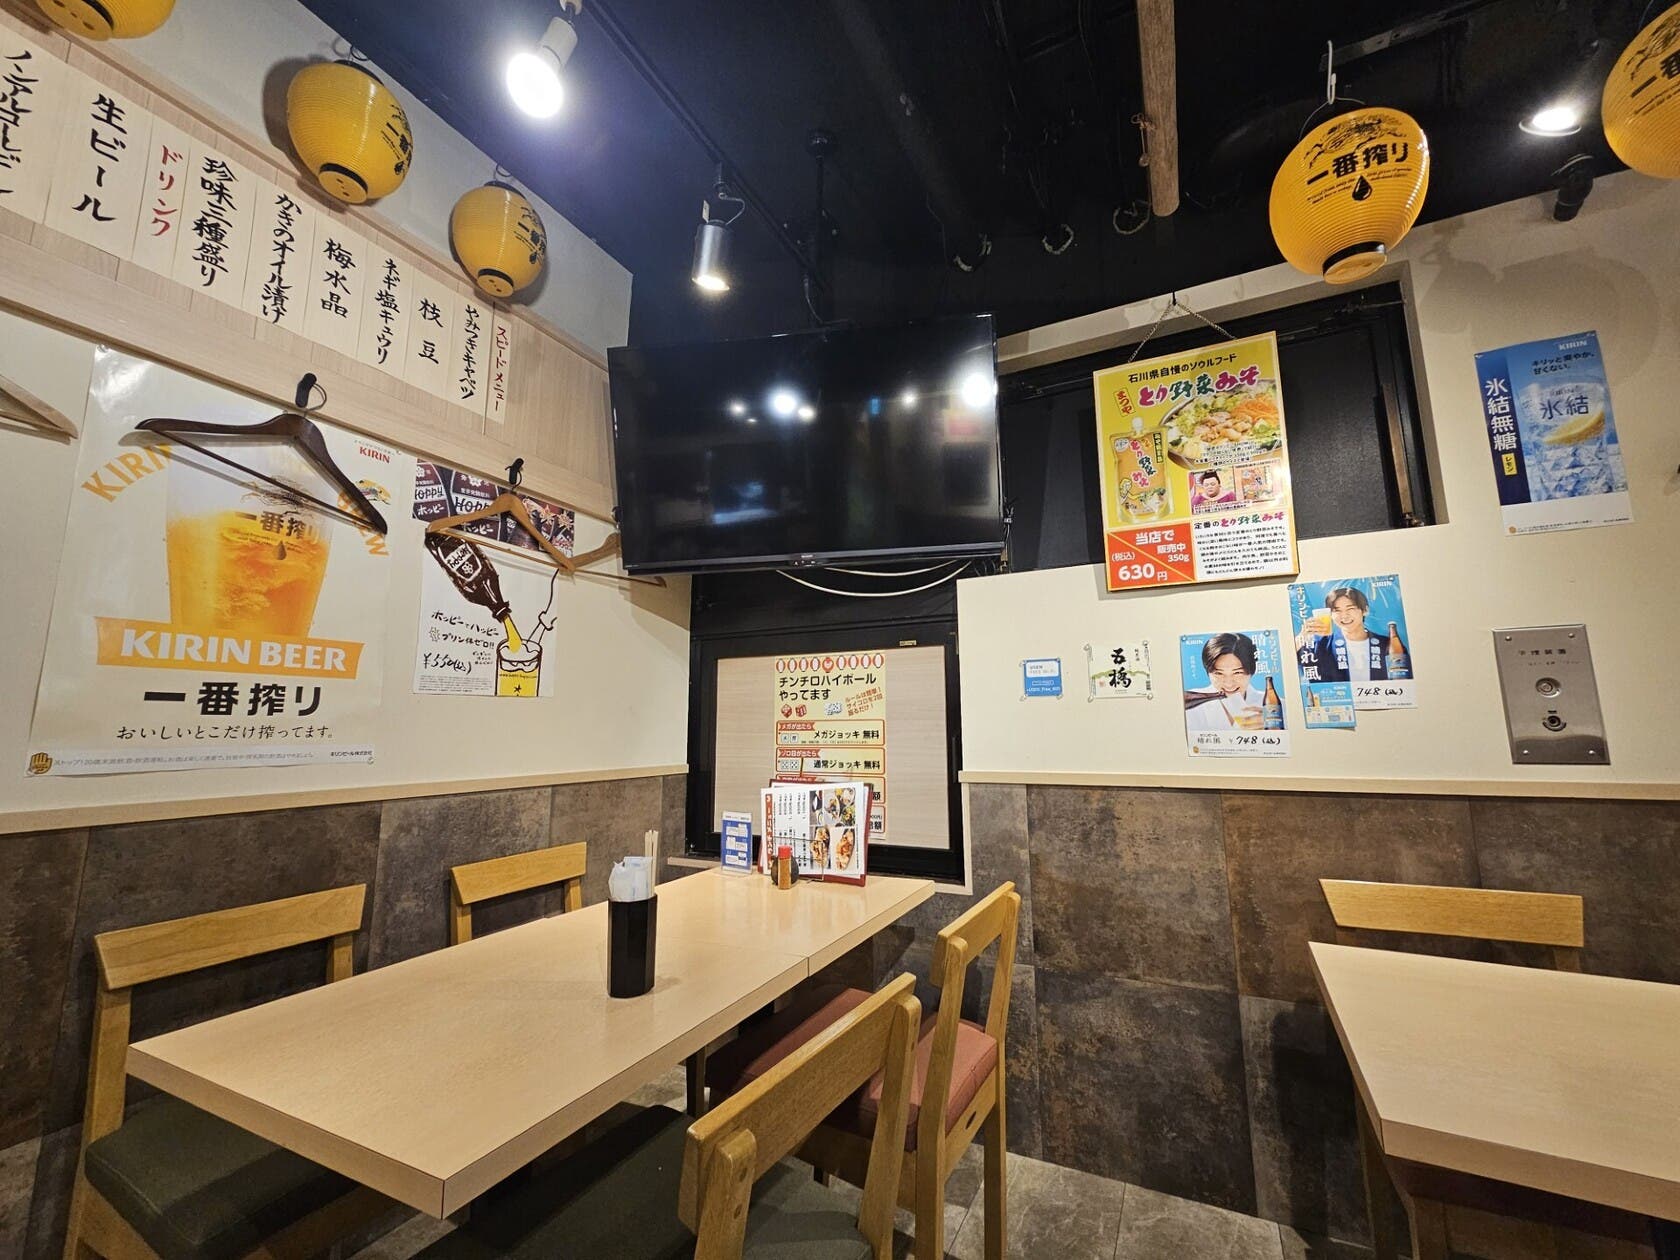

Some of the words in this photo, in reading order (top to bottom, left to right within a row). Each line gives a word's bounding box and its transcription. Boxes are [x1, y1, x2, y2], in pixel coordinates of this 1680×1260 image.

[72, 93, 127, 221] 生ビール
[1307, 142, 1409, 185] 一番搾り
[151, 144, 183, 237] ドリンク
[191, 156, 239, 287] 珍味三種盛り
[261, 193, 302, 324] かきのオイル漬け
[320, 238, 356, 318] 梅水晶
[374, 258, 401, 364] ネギ塩キュウリ
[418, 298, 443, 364] 枝豆
[459, 304, 481, 400] やみつきキャベツ
[1558, 340, 1588, 351] KIRIN
[493, 326, 509, 412] スピードメニュー
[1128, 353, 1238, 384] 石川県自慢のソウルフード
[1138, 365, 1260, 406] とり野菜みそ
[1484, 377, 1518, 451] 氷結無糖
[1539, 395, 1590, 420] 氷結
[360, 446, 390, 464] KIRIN
[417, 503, 445, 516] ホッピー
[1135, 529, 1175, 546] 当店で
[1156, 542, 1187, 555] 販売中
[1111, 551, 1136, 562] (税込)
[1167, 553, 1190, 563] 350g
[120, 628, 251, 665] KIRIN
[259, 641, 347, 671] BEER
[779, 673, 877, 688] チンチロハイボール
[780, 688, 832, 701] やってます
[1357, 687, 1381, 697] 748
[143, 681, 322, 717] 一番搾り
[116, 725, 334, 740] おいしいとこだけ搾ってます。
[814, 730, 861, 740] メガジョッキ
[862, 730, 880, 739] 無料
[1236, 735, 1258, 746] 748
[814, 759, 862, 769] 通常ジョッキ
[863, 760, 881, 770] 無料
